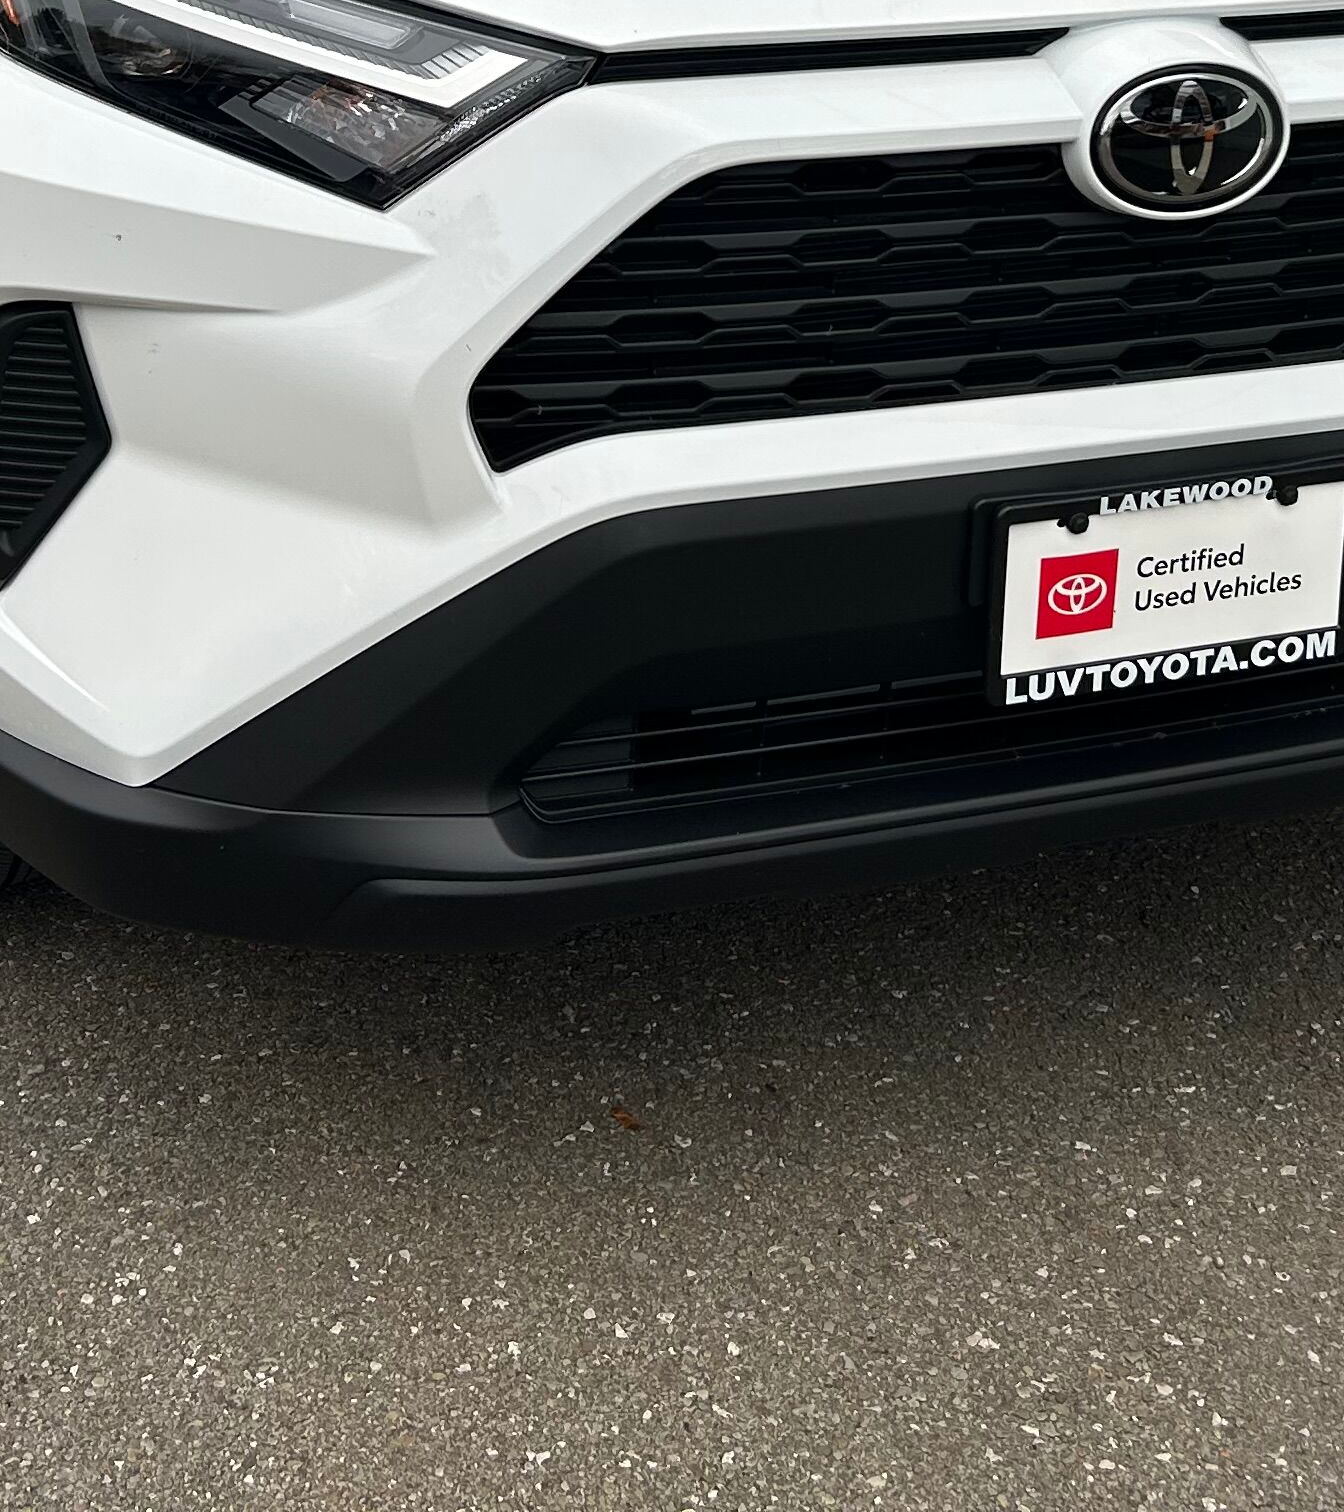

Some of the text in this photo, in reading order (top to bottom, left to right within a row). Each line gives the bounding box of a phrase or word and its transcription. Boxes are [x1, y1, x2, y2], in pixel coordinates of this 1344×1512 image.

[1099, 475, 1274, 516] LAKEWOOD
[1136, 543, 1245, 579] Certified
[1134, 571, 1303, 611] Used Vehicles
[1005, 630, 1337, 706] LUVTOYOTA.COM
